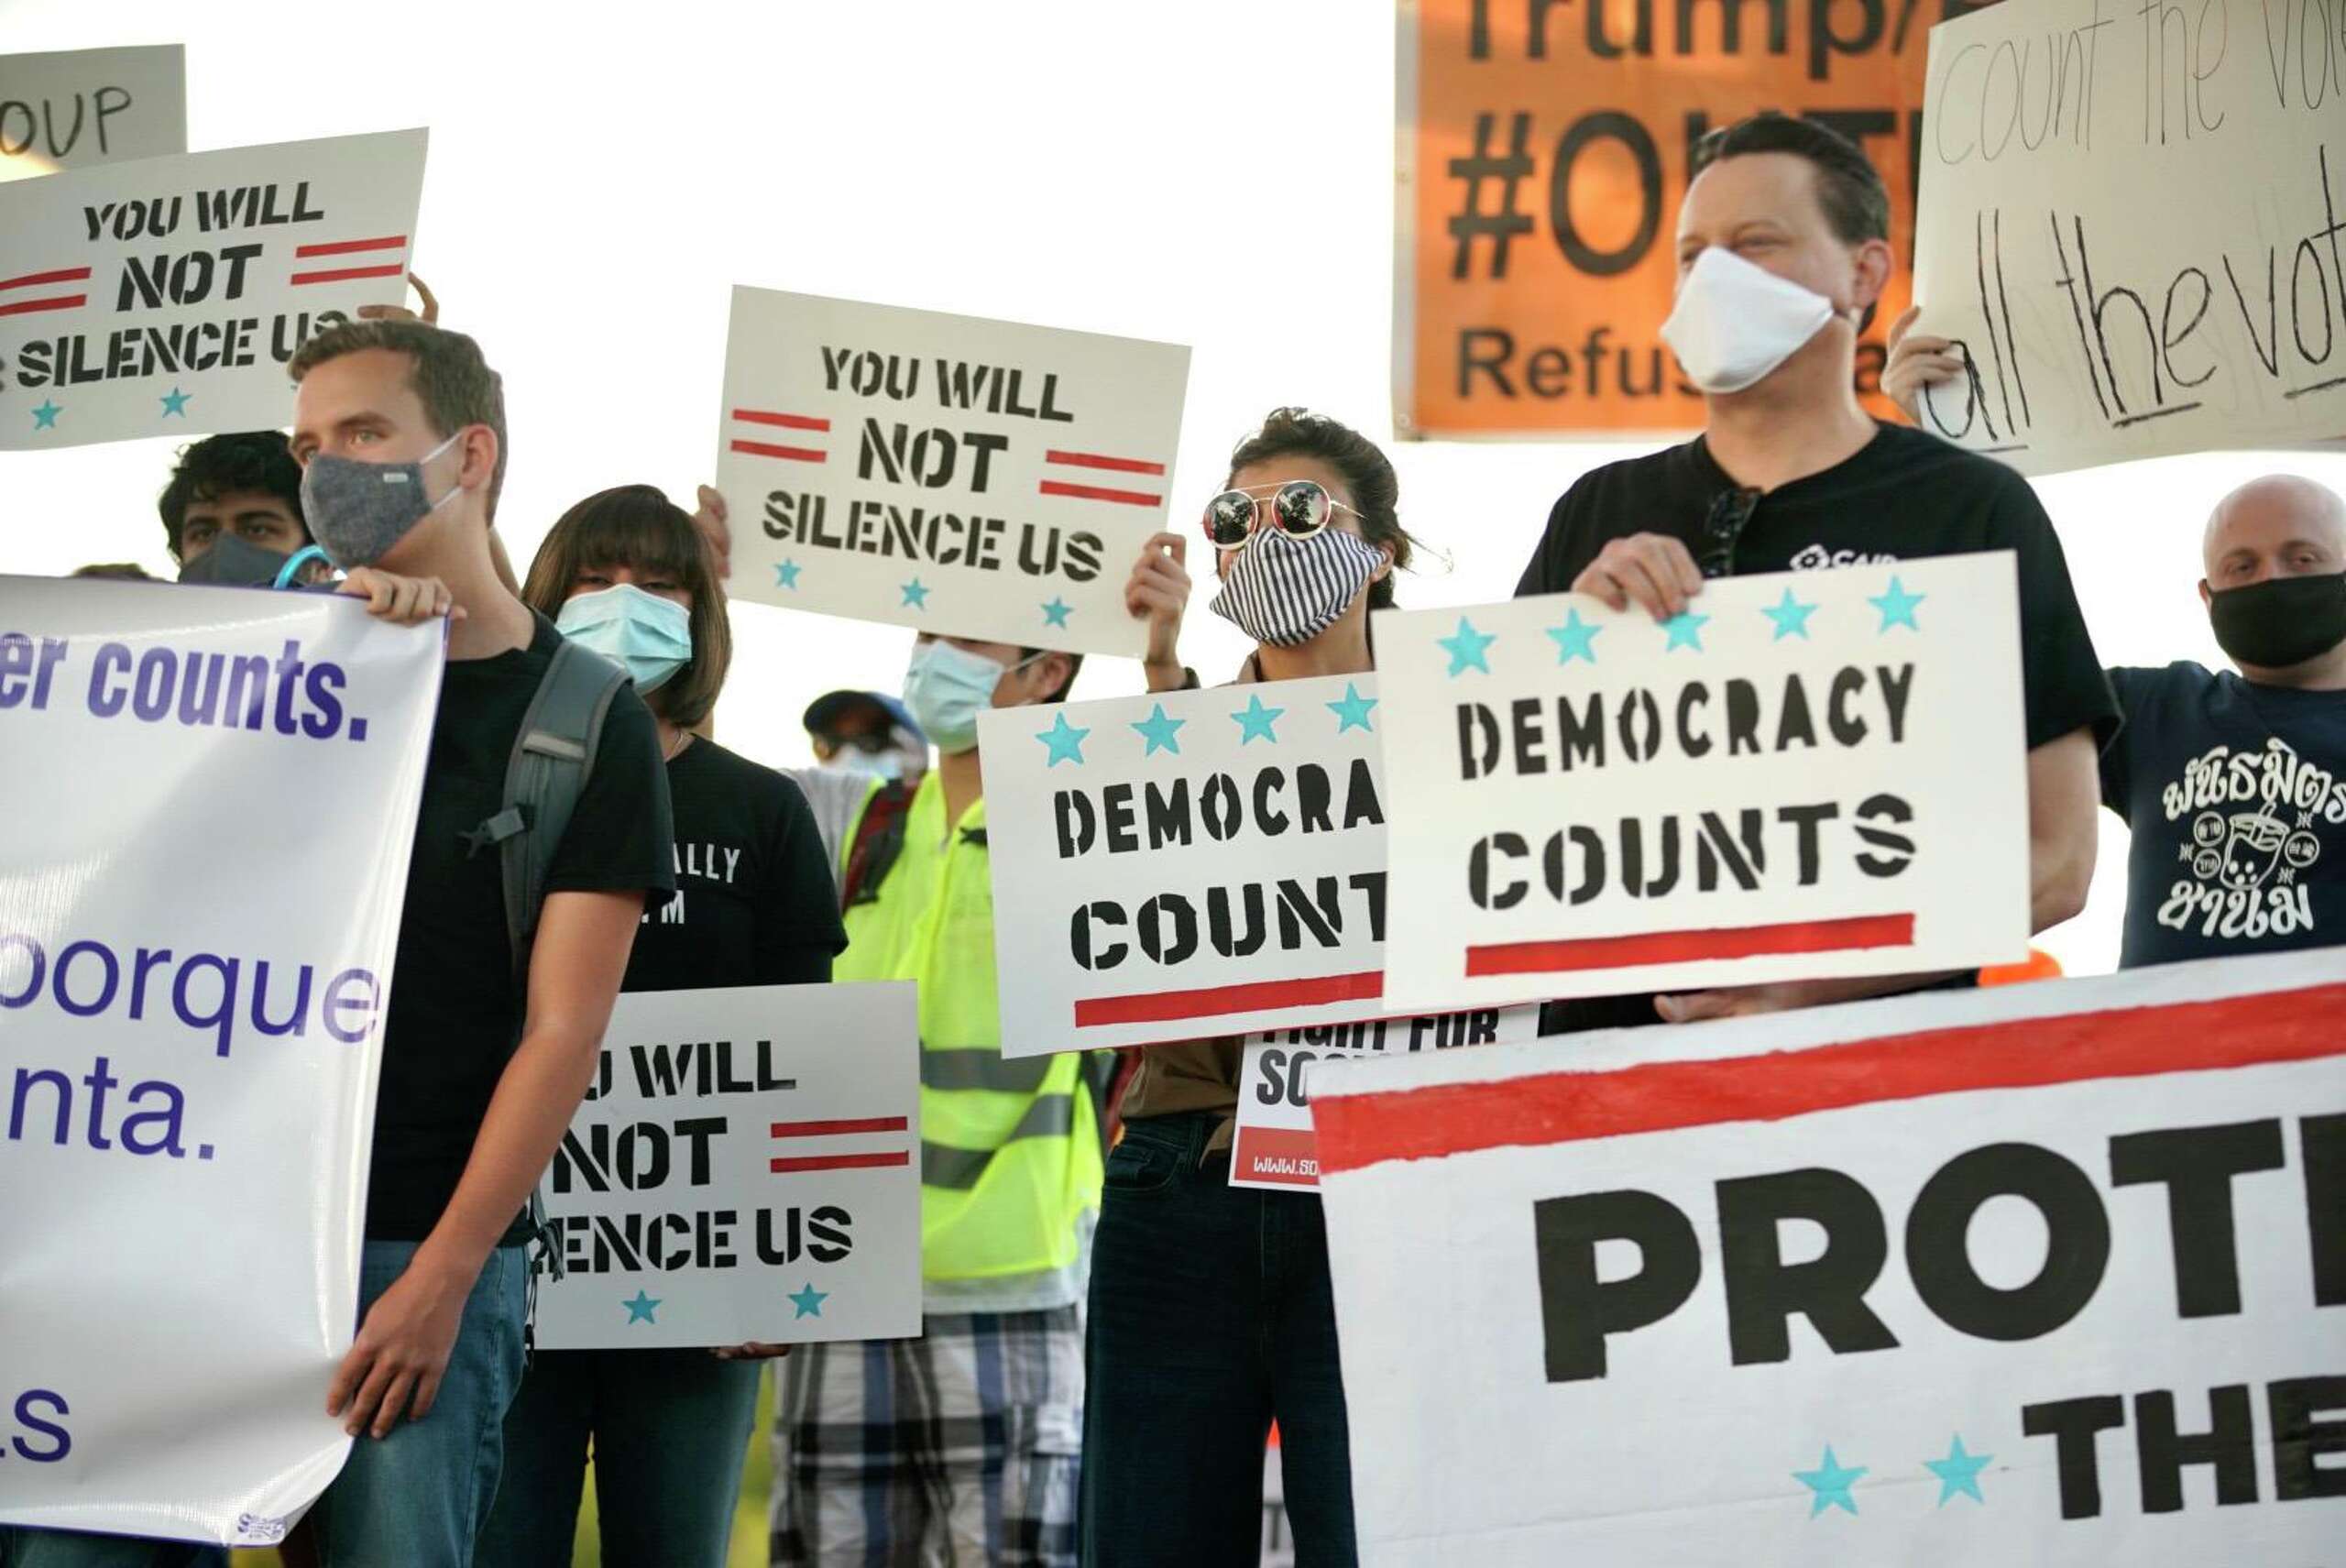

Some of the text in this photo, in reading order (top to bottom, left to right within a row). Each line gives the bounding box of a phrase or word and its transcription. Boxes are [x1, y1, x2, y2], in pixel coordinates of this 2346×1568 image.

[2138, 0, 2227, 145] the
[2263, 0, 2346, 110] vot
[0, 85, 132, 158] OUP
[82, 181, 324, 243] YOU WILL
[115, 243, 263, 313] NOT
[16, 318, 258, 389] SILENCE
[1455, 325, 1714, 401] Refu
[1925, 208, 2030, 441] all
[2051, 210, 2217, 420] the
[821, 345, 1074, 422] YOU WILL
[857, 418, 1008, 493] NOT
[762, 489, 1104, 582] SILENCE US
[88, 639, 368, 741] counts.
[1456, 662, 1916, 781] DEMOCRACY
[1053, 757, 1386, 859] DEMOCRA
[1468, 793, 1916, 911] COUNTS
[1069, 871, 1388, 971] COUNT
[8, 1056, 215, 1160] nta.
[630, 1040, 797, 1099] WILL
[552, 1116, 729, 1194] NOT
[532, 1205, 853, 1275] ENCE US
[2022, 1375, 2346, 1521] THE
